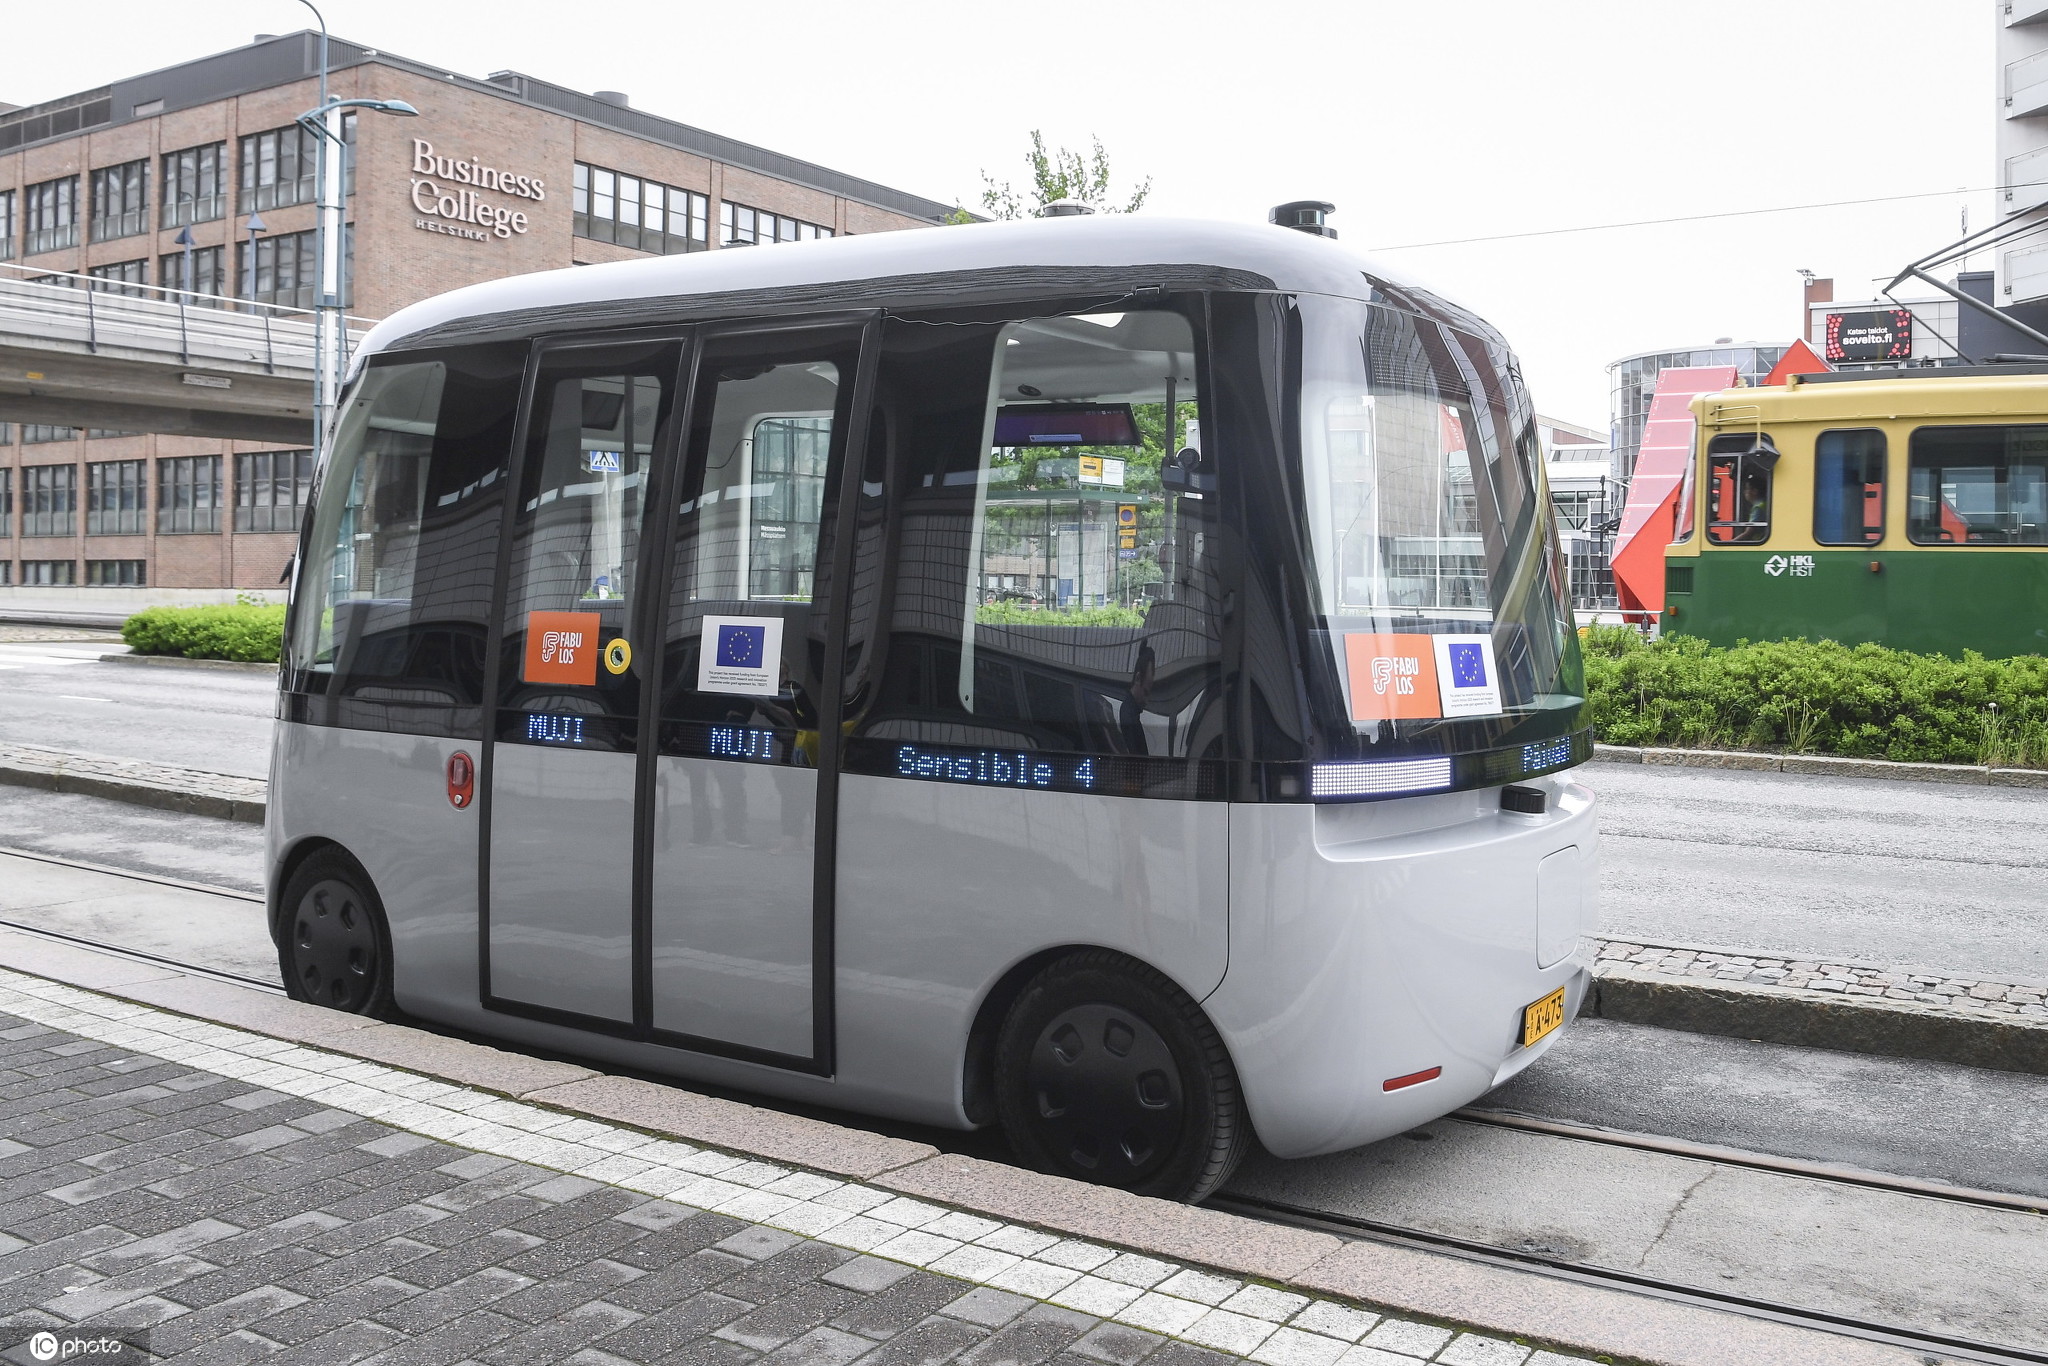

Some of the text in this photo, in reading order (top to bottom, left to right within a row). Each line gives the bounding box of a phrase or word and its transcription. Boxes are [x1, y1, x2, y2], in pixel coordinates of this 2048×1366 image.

[412, 138, 546, 201] Business
[411, 179, 529, 239] College
[416, 218, 490, 242] HELSINKI
[1842, 333, 1893, 345] sovelto.fi
[1790, 555, 1816, 566] HKL
[1789, 565, 1816, 577] HST
[560, 631, 583, 648] FABU
[558, 648, 575, 664] LOS
[1393, 657, 1419, 676] FABU
[1395, 677, 1415, 695] LOS
[528, 714, 584, 743] MUJI
[710, 727, 773, 758] MUJI
[898, 746, 1094, 788] Sensible 4
